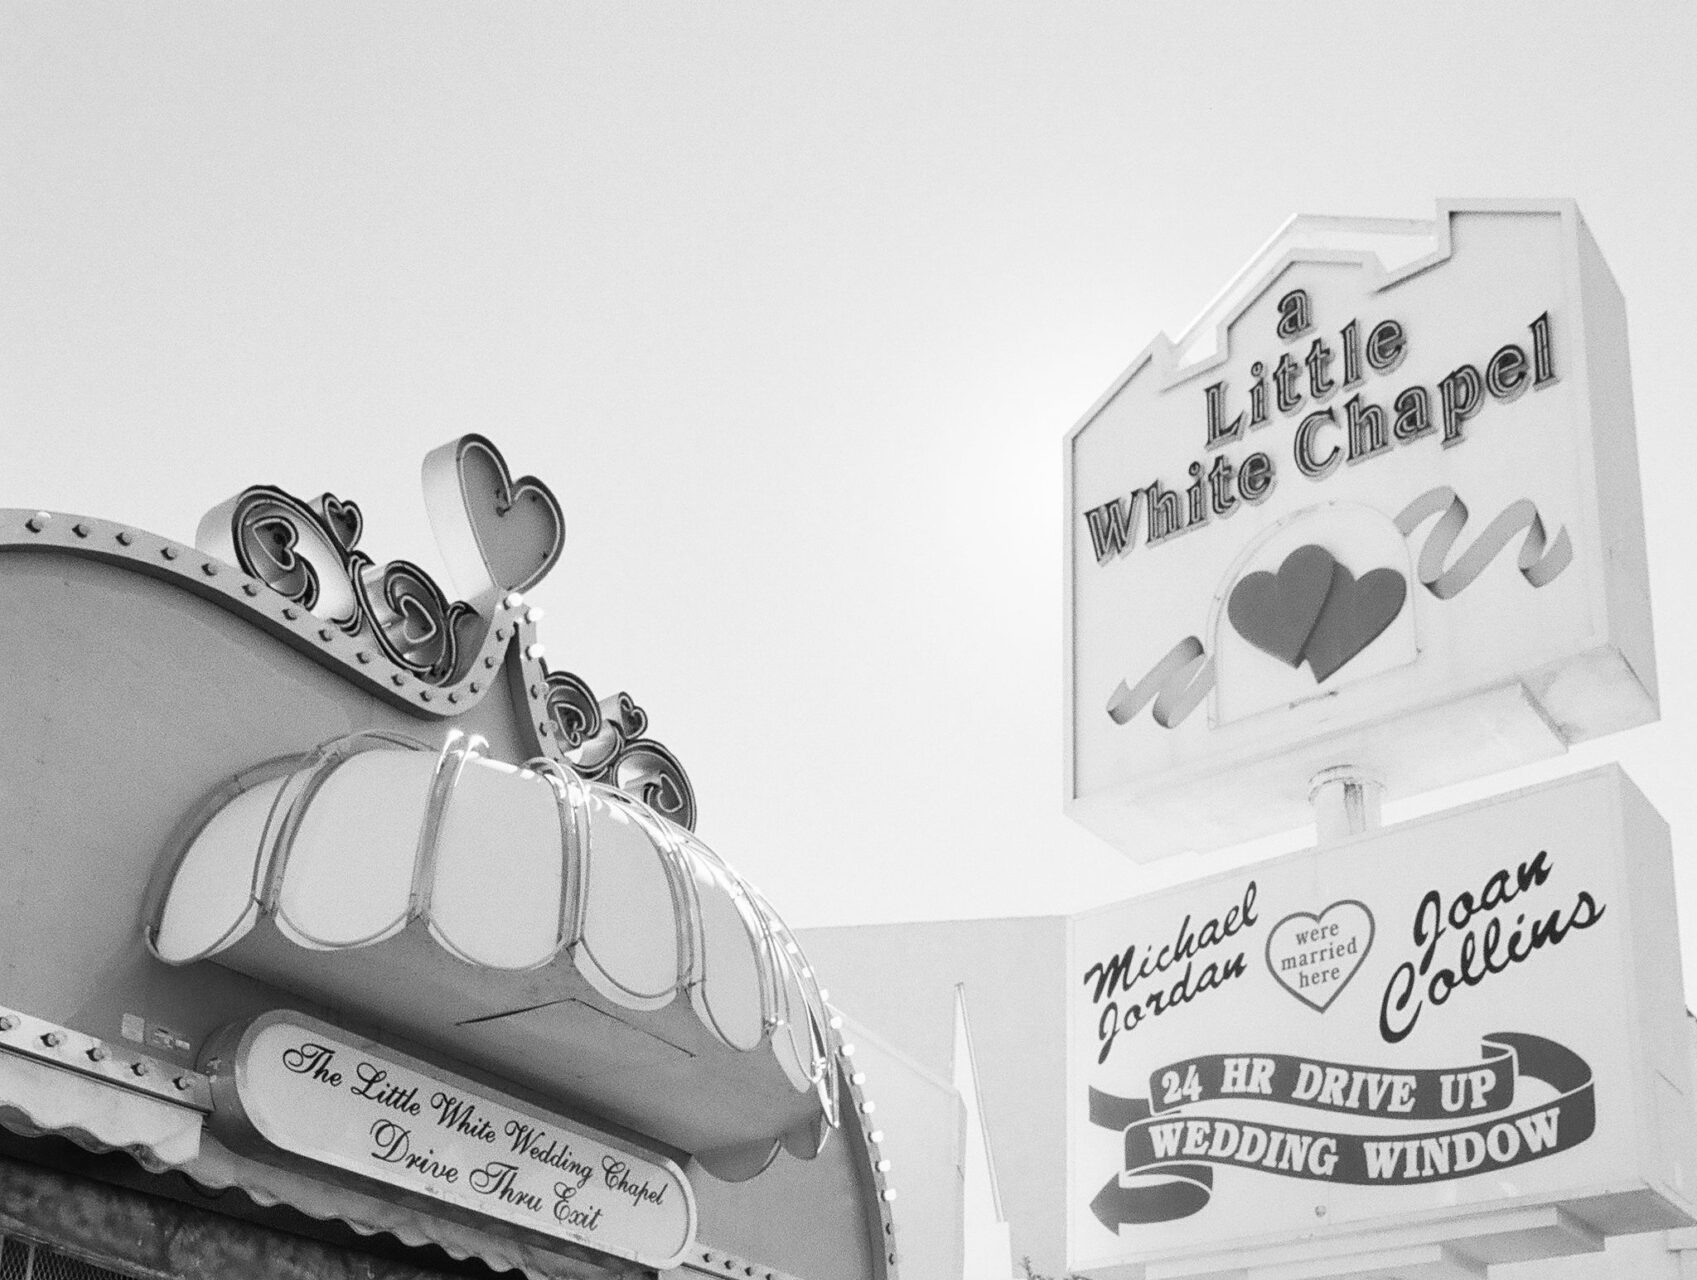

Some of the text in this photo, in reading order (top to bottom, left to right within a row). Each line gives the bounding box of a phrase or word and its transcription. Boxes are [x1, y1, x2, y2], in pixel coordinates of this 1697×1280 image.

[1276, 289, 1312, 340] a
[1083, 310, 1560, 563] White Chapel
[1204, 319, 1407, 450] Little
[1083, 880, 1258, 1003] Michael
[1280, 936, 1359, 972] married
[1295, 922, 1339, 947] were
[1379, 891, 1607, 1044] Collins
[1412, 850, 1554, 976] Joan
[1097, 951, 1247, 1065] Jordan
[1298, 963, 1341, 989] here
[282, 1043, 669, 1206] The Little White Wedding Chapel
[1161, 1057, 1498, 1113] 24 HR DRIVE UP
[370, 1119, 604, 1231] Drive Thru Exit
[1149, 1107, 1562, 1179] WEDDING WINDOW
